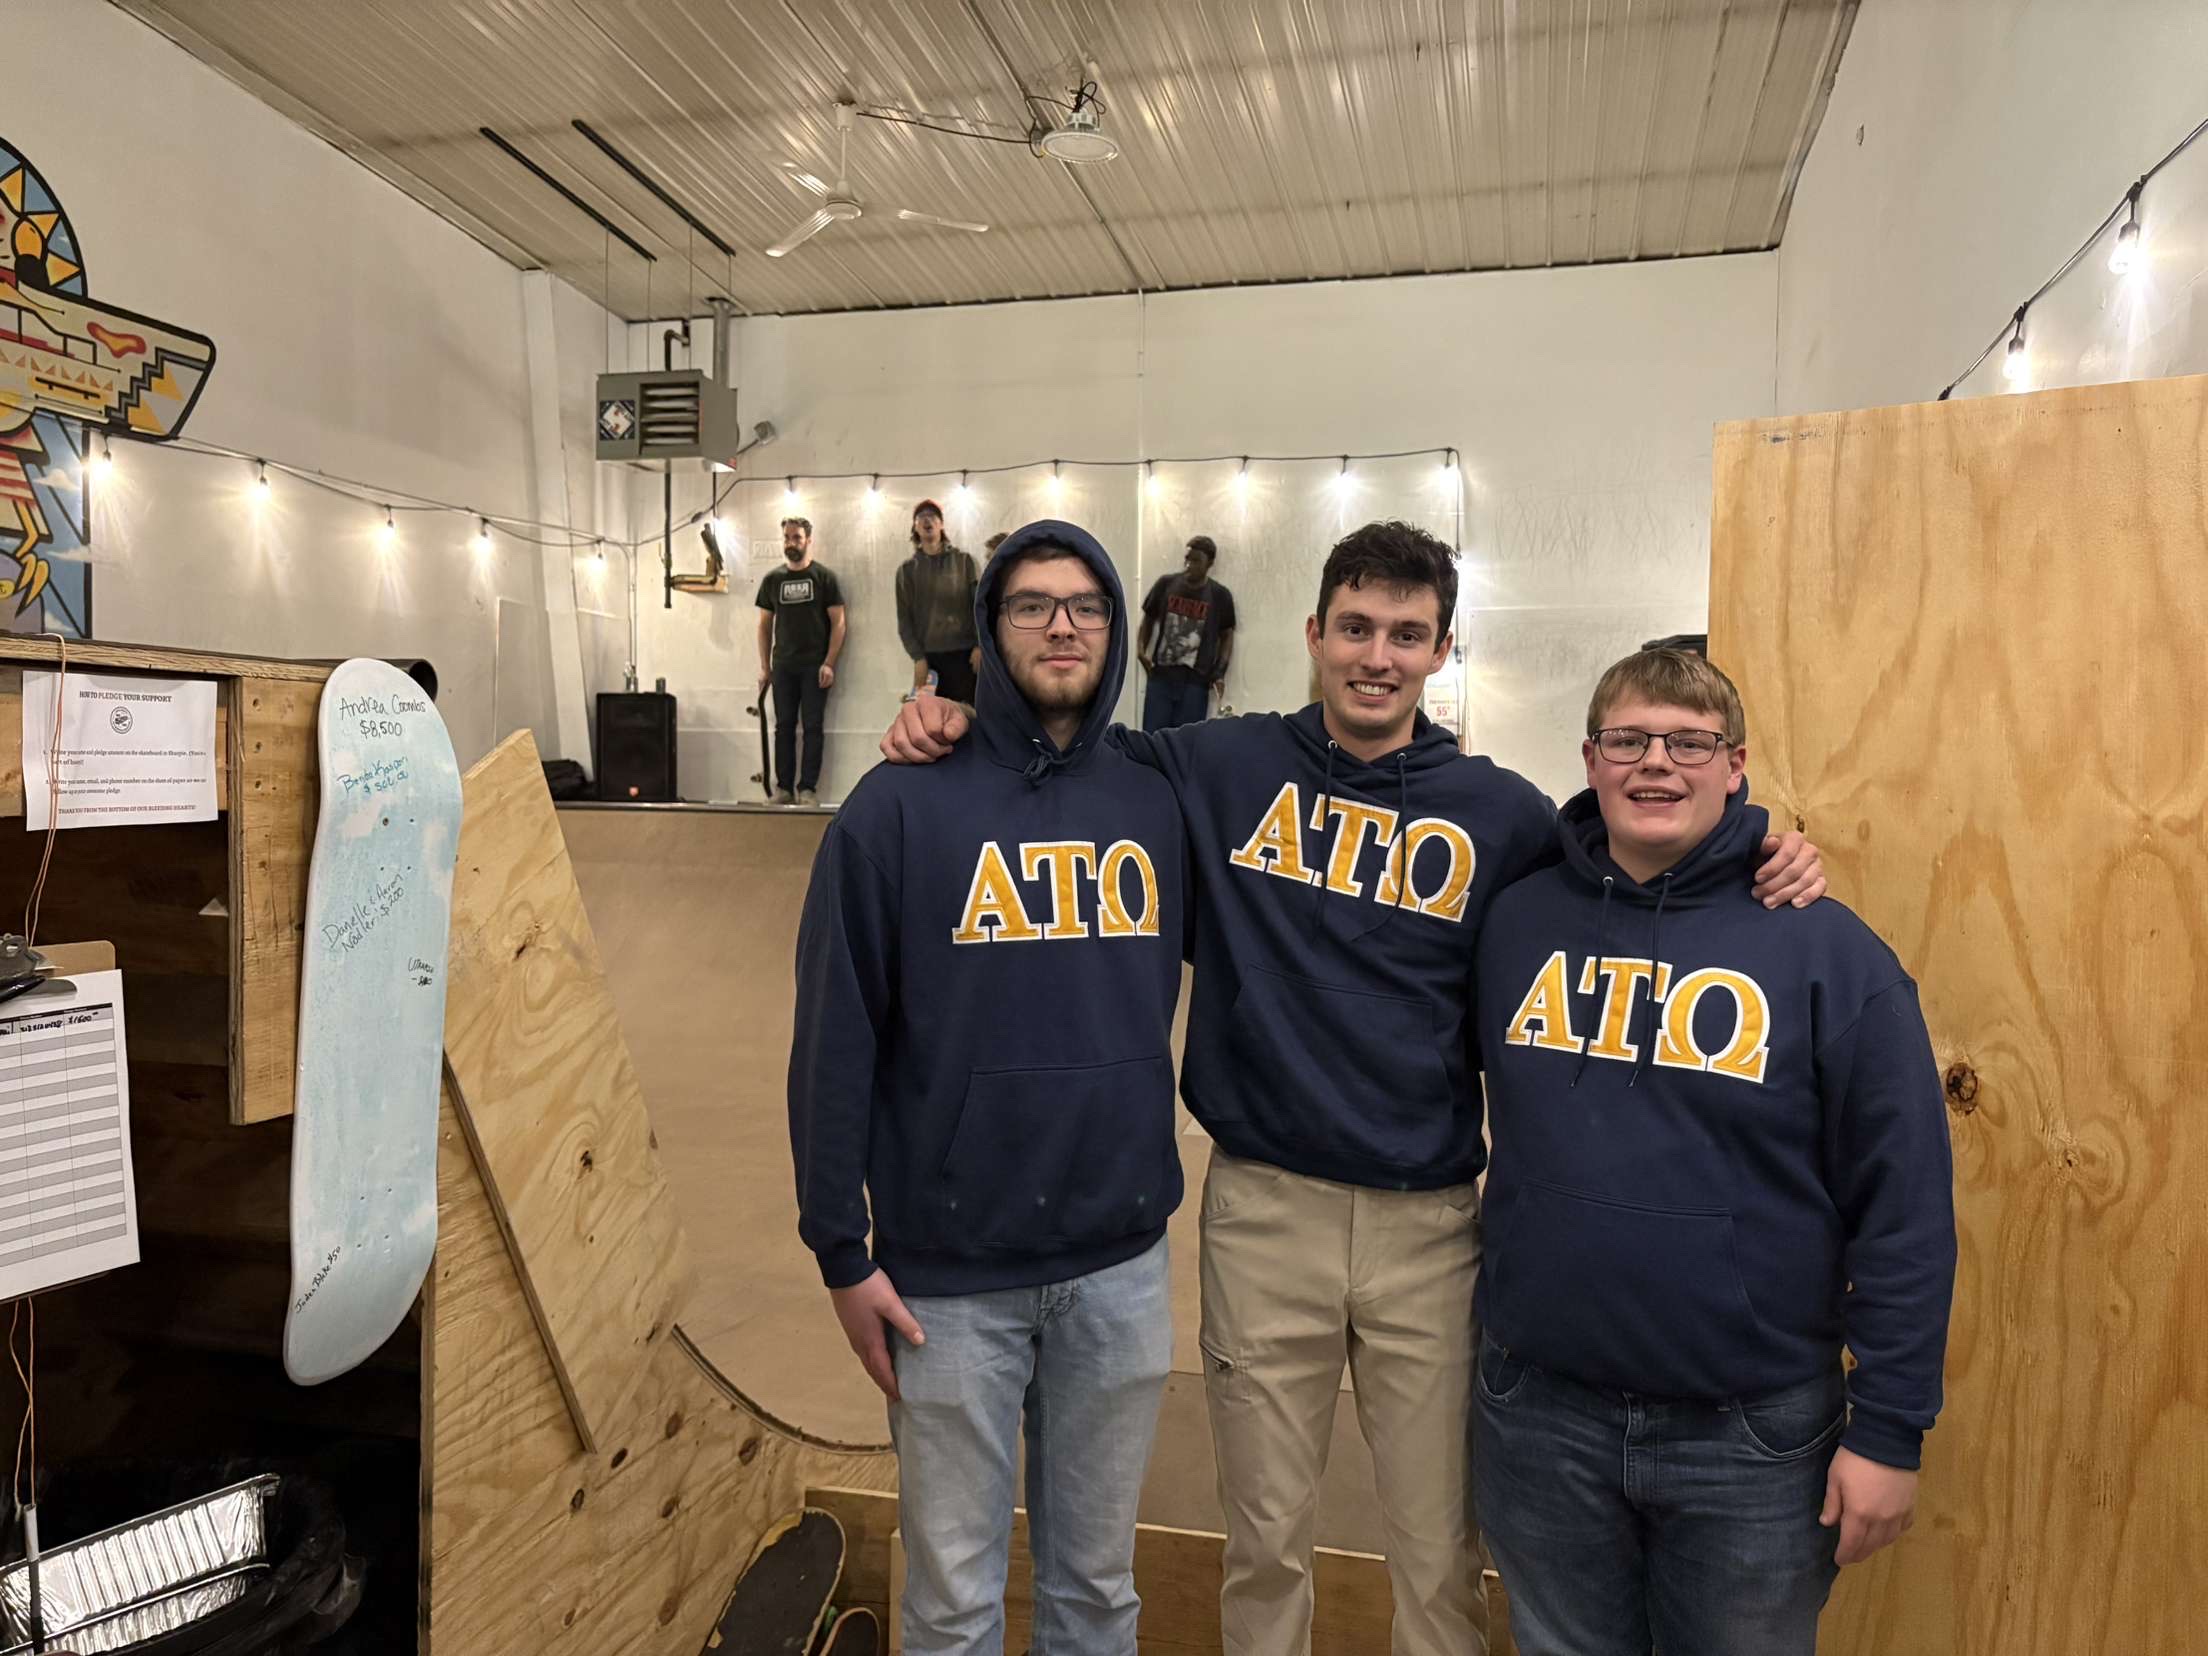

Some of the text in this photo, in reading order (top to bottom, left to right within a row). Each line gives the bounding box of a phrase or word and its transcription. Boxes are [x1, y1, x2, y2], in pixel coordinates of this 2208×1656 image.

[98, 692, 123, 701] PLEDGE
[123, 694, 141, 702] YOUR
[141, 694, 172, 703] SUPPORT
[339, 696, 388, 720] Andrea
[360, 720, 402, 739] $8,500
